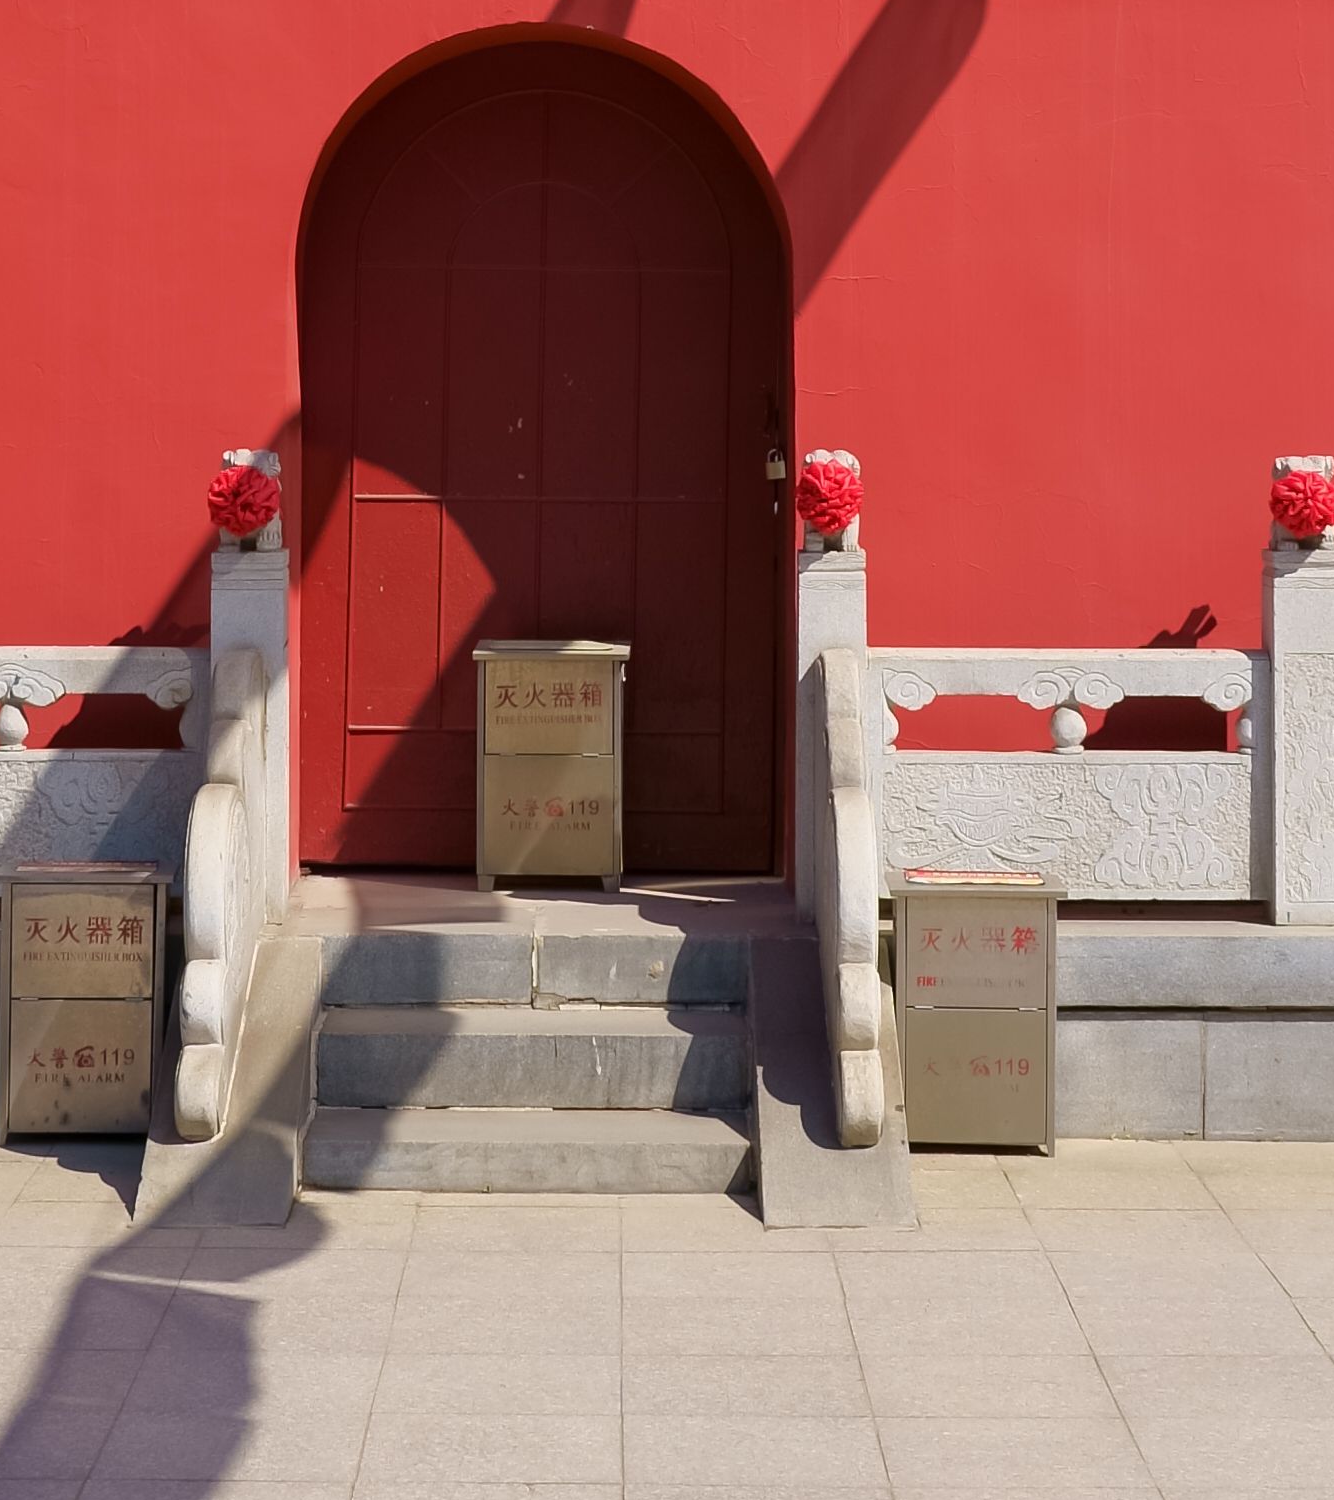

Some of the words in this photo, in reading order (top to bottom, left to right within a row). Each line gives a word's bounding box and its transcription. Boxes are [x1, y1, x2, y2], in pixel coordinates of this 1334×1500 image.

[494, 680, 603, 709] 灭火器箱
[567, 799, 600, 816] 119
[25, 915, 146, 945] 灭火器箱
[919, 925, 1040, 955] 灭火器箱
[122, 951, 144, 962] BOX
[27, 1046, 69, 1069] 火警
[100, 1047, 136, 1067] 119
[994, 1057, 1030, 1076] 119
